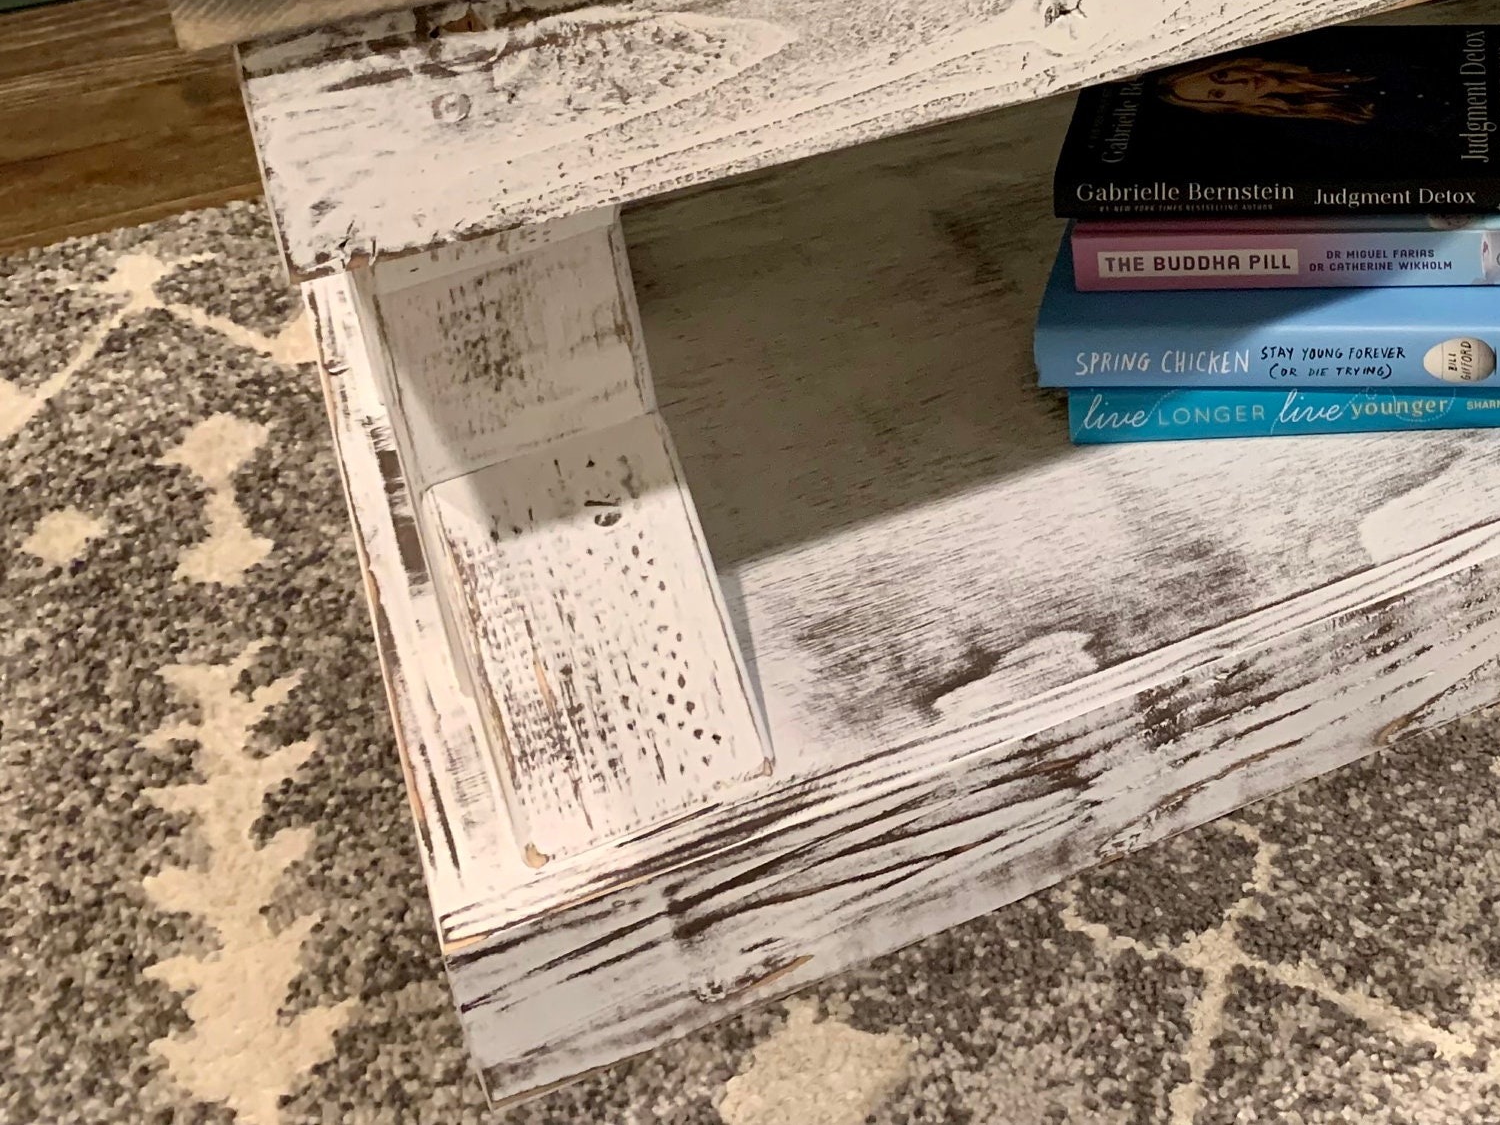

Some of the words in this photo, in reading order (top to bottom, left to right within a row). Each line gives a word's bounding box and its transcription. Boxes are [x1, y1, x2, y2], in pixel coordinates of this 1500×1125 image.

[1459, 30, 1486, 76] Detox
[1101, 99, 1138, 164] Gabrielle
[1458, 80, 1497, 164] Judgment
[1076, 181, 1180, 202] Gabrielle
[1188, 182, 1294, 201] Bernstein
[1314, 188, 1411, 207] Judgment
[1418, 188, 1476, 204] Detox
[1114, 205, 1130, 213] NEW
[1159, 204, 1183, 213] TIMES
[1186, 204, 1239, 212] BESTSELLING
[1242, 203, 1273, 211] AUTHOR
[1104, 256, 1144, 272] THE
[1153, 254, 1240, 271] BUDDHA
[1249, 254, 1291, 270] PILL
[1326, 250, 1342, 260] DR
[1346, 249, 1388, 260] MIGUEL
[1393, 248, 1435, 258] FARIAS
[1309, 262, 1325, 272] DR
[1329, 262, 1394, 271] CATHERINE
[1398, 261, 1453, 271] WIKHOLM
[1075, 351, 1151, 376] SPRING
[1161, 349, 1250, 375] CHICKEN
[1260, 346, 1294, 361] STAY
[1302, 347, 1343, 361] YOUNG
[1348, 346, 1406, 360] FOREVER
[1269, 363, 1298, 380] (OR
[1308, 367, 1329, 377] DIE
[1336, 364, 1393, 380] TRYING)
[1083, 393, 1151, 429] live
[1157, 404, 1265, 425] LONGER
[1278, 388, 1346, 423] live
[1350, 398, 1449, 420] younger
